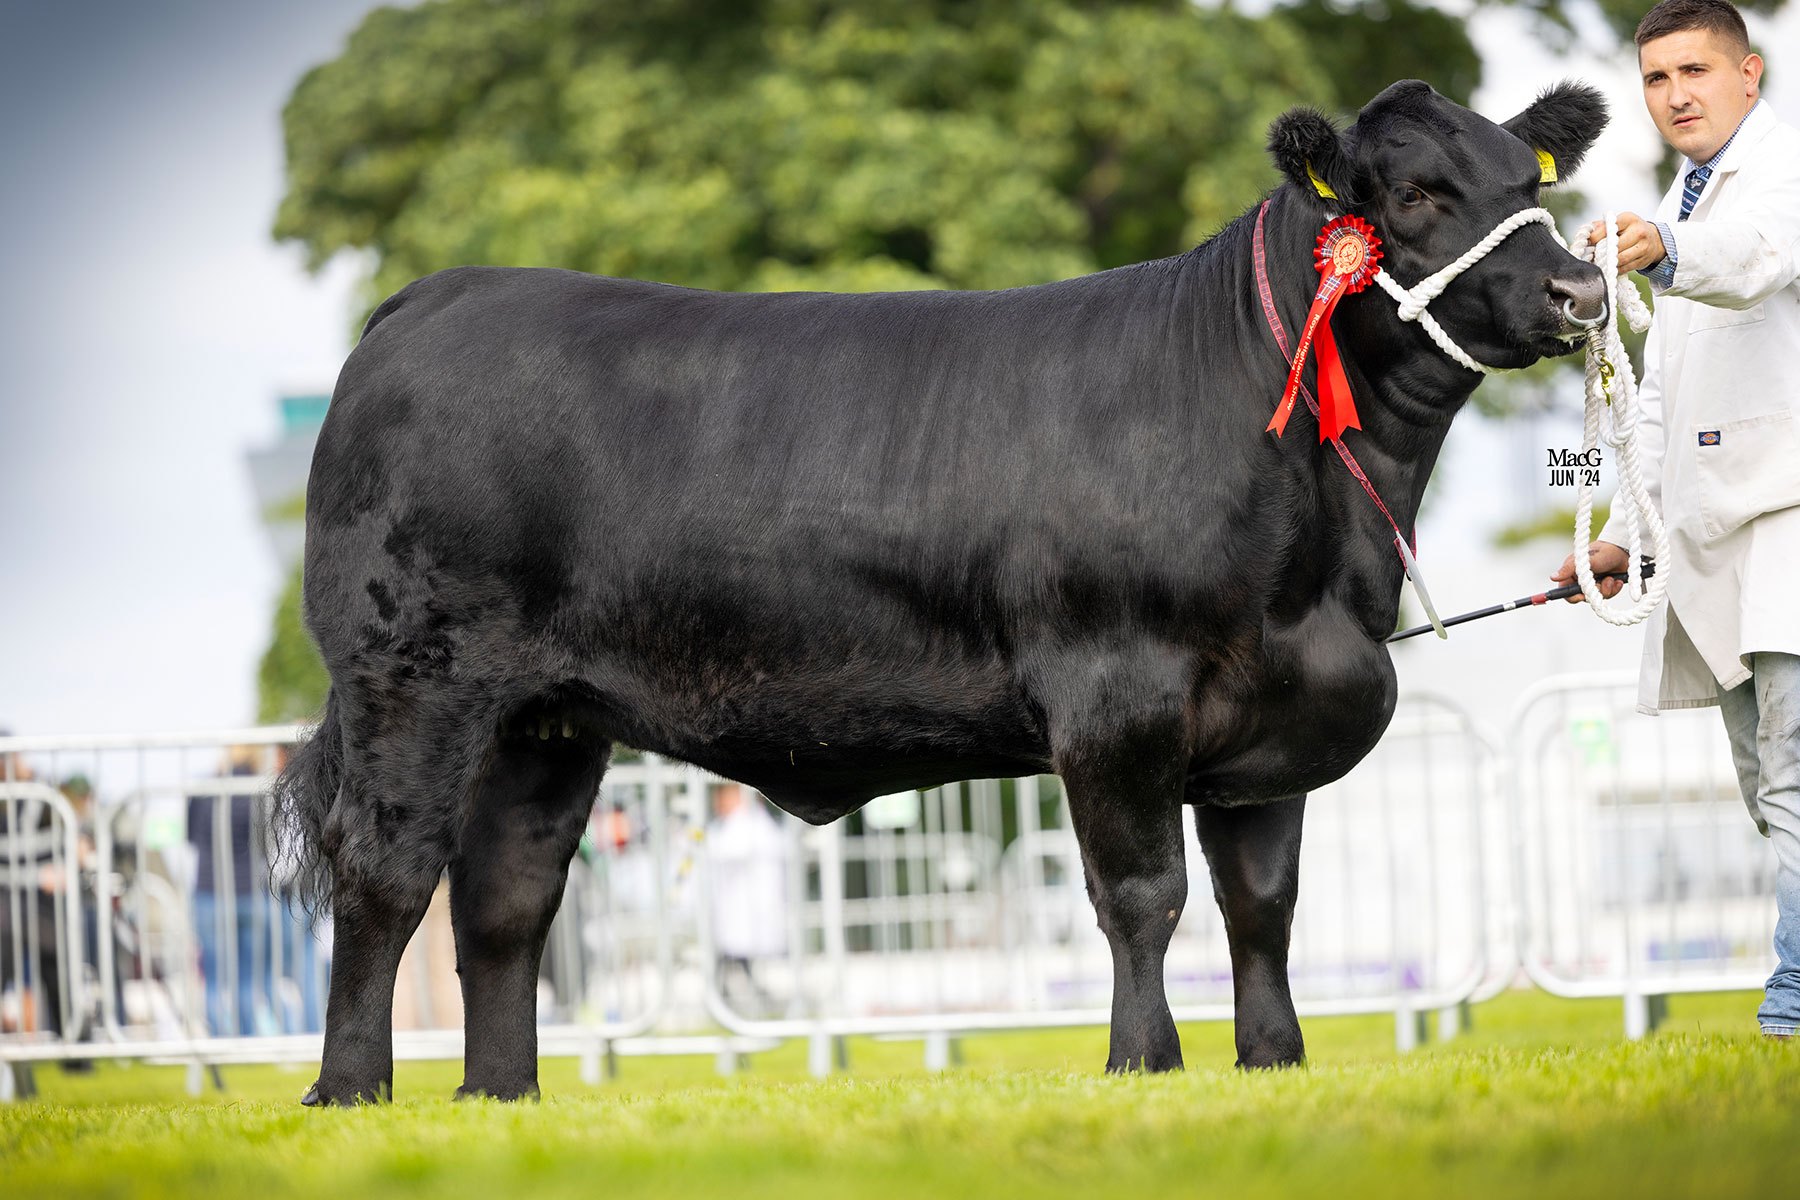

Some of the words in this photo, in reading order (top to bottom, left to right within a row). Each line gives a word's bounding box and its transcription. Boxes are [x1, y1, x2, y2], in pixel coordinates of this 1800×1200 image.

[1307, 314, 1320, 339] Royal
[1292, 347, 1301, 370] 2024
[1294, 342, 1309, 383] Highland
[1287, 385, 1298, 411] Show
